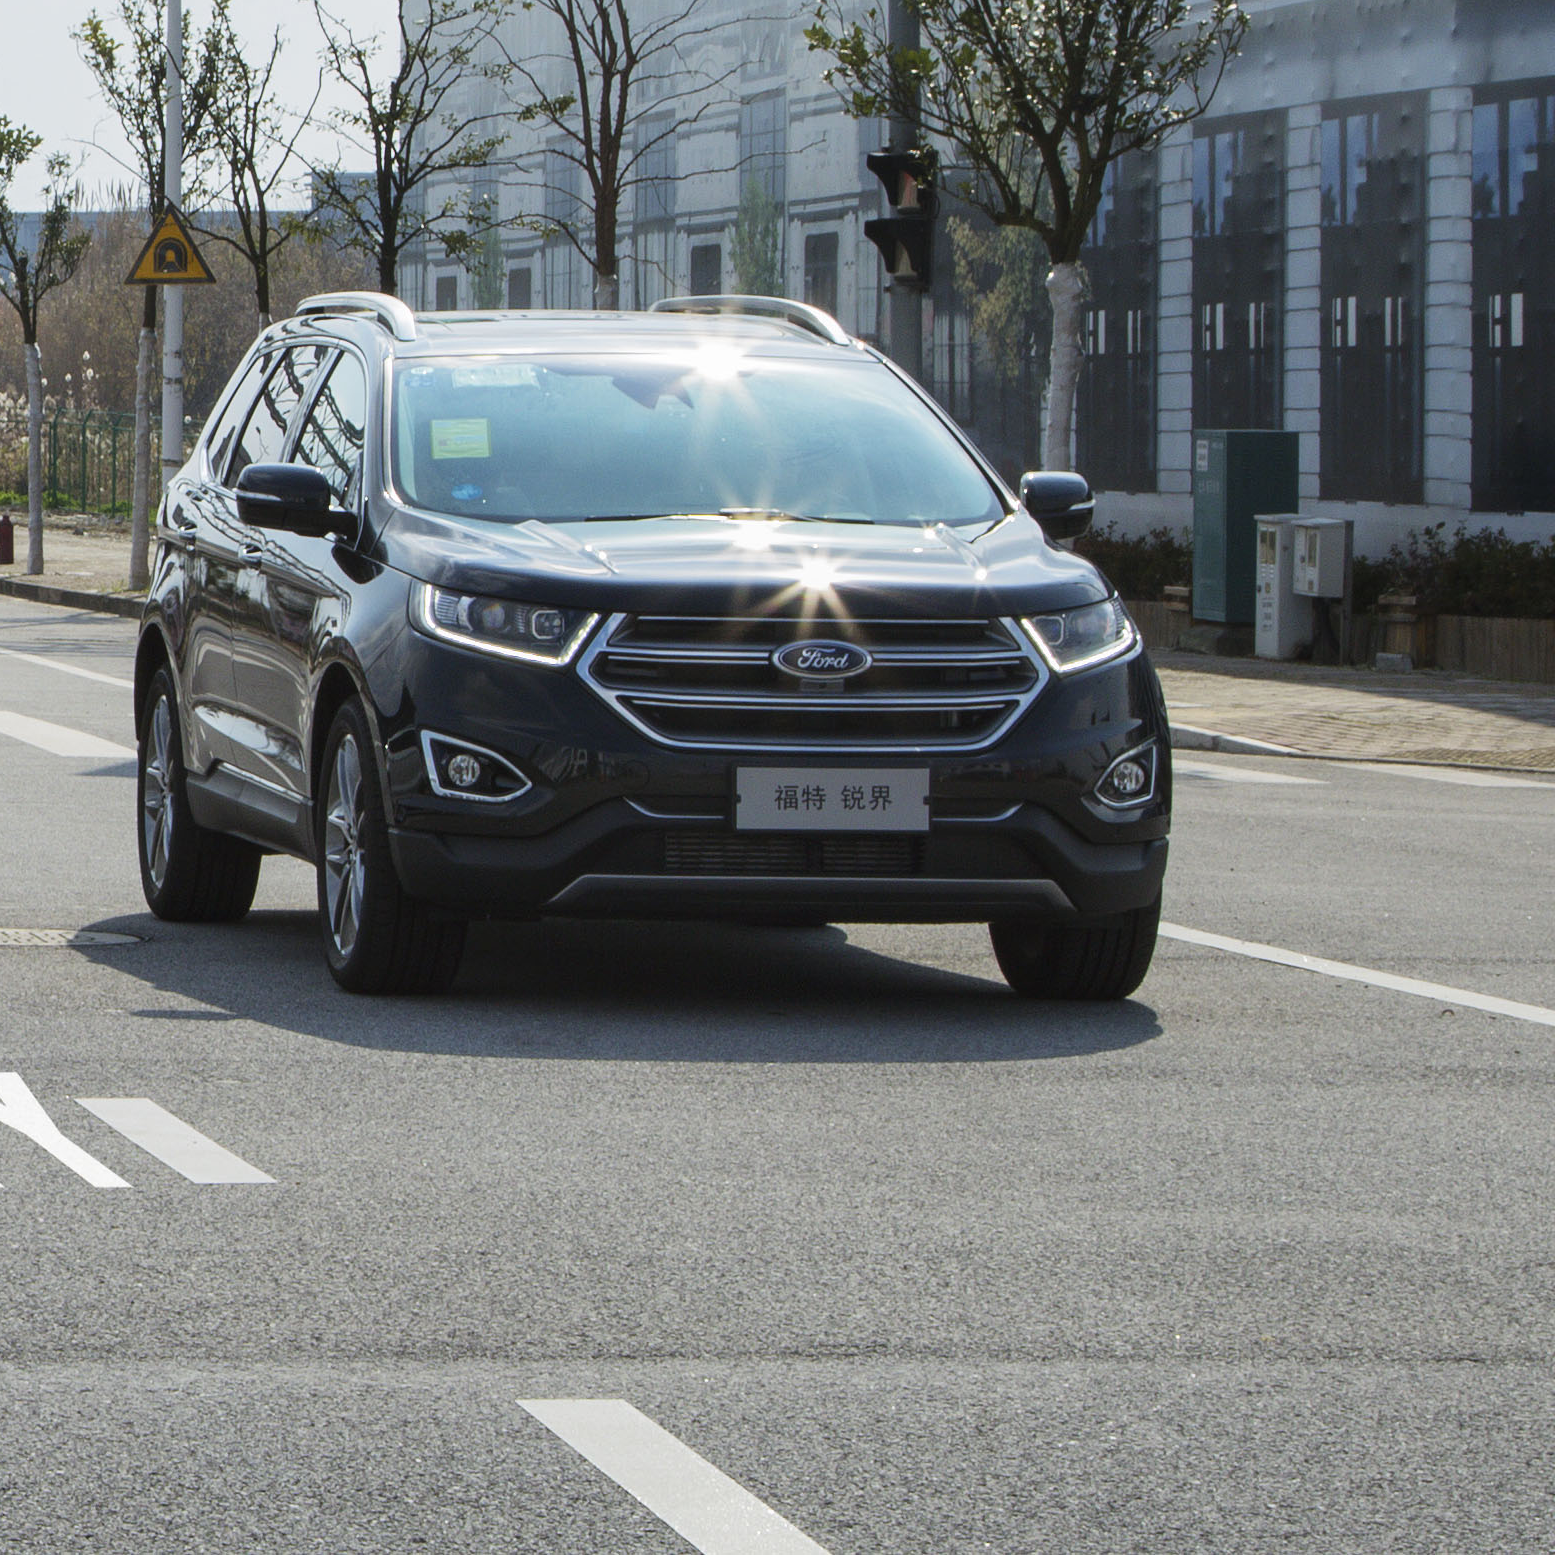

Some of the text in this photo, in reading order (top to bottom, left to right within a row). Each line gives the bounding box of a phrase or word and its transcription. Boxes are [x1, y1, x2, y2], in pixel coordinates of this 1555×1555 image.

[796, 646, 849, 669] Ford
[773, 784, 893, 811] 福特 锐界
